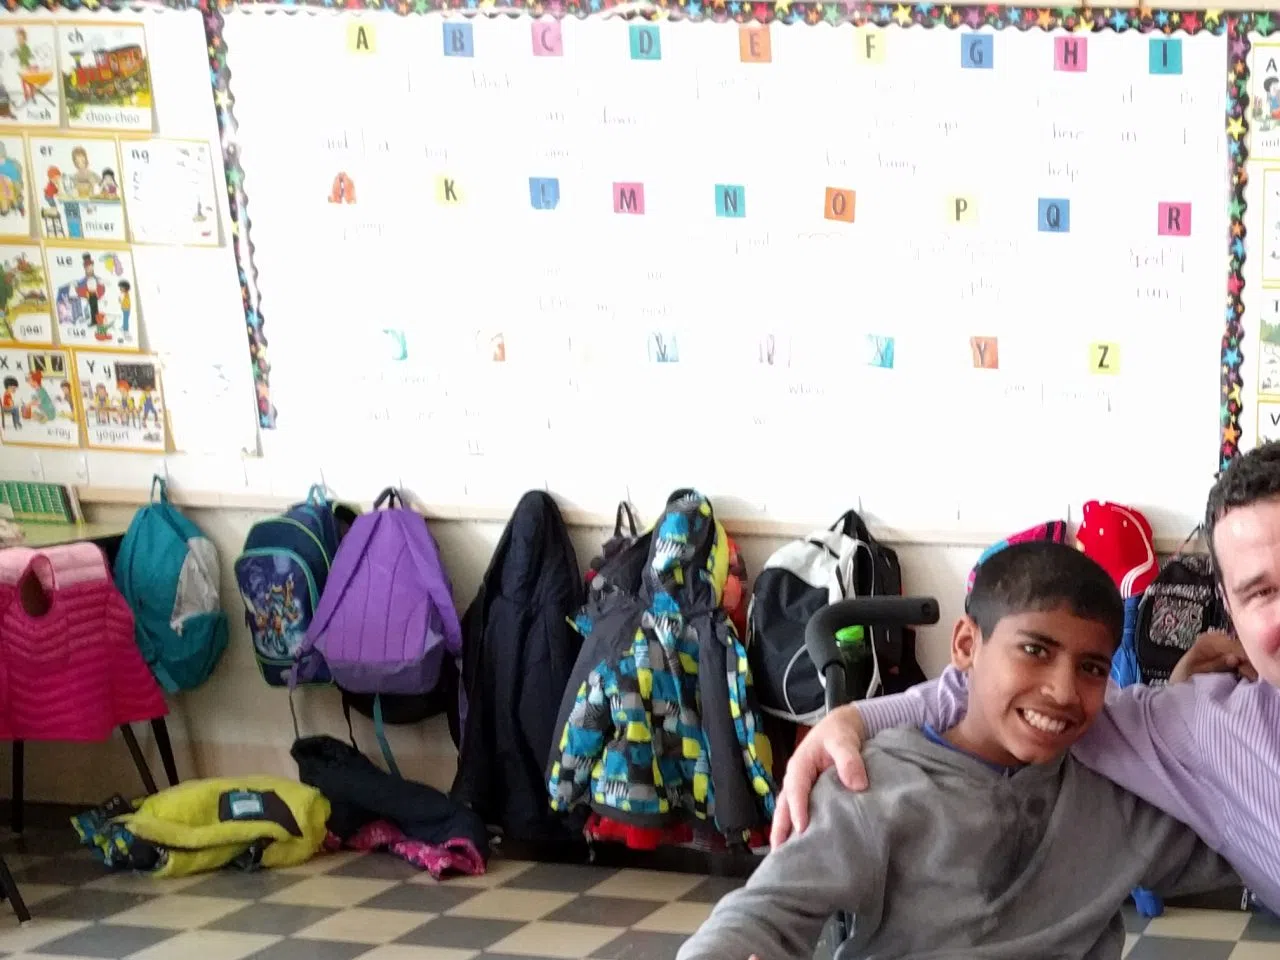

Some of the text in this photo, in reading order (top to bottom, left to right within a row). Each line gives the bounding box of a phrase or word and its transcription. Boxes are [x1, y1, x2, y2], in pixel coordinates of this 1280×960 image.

[67, 28, 84, 44] ch
[356, 25, 370, 50] A
[451, 27, 466, 52] B
[540, 27, 555, 52] C
[639, 29, 654, 55] D
[749, 31, 762, 58] E
[865, 33, 876, 59] F
[969, 39, 984, 65] G
[1063, 40, 1078, 67] H
[1161, 41, 1169, 68] I
[1266, 56, 1278, 73] A
[86, 109, 140, 124] choo-choo
[131, 149, 149, 164] ng
[444, 178, 458, 202] K
[619, 187, 638, 213] M
[723, 187, 739, 214] N
[831, 191, 847, 217] O
[954, 197, 968, 221] P
[85, 220, 115, 233] mixer
[1046, 203, 1061, 231] Q
[1167, 205, 1181, 232] R
[55, 255, 73, 267] ue
[0, 355, 23, 371] X x
[86, 360, 112, 379] Y y
[1097, 344, 1111, 370] Z
[96, 428, 130, 442] yogurt
